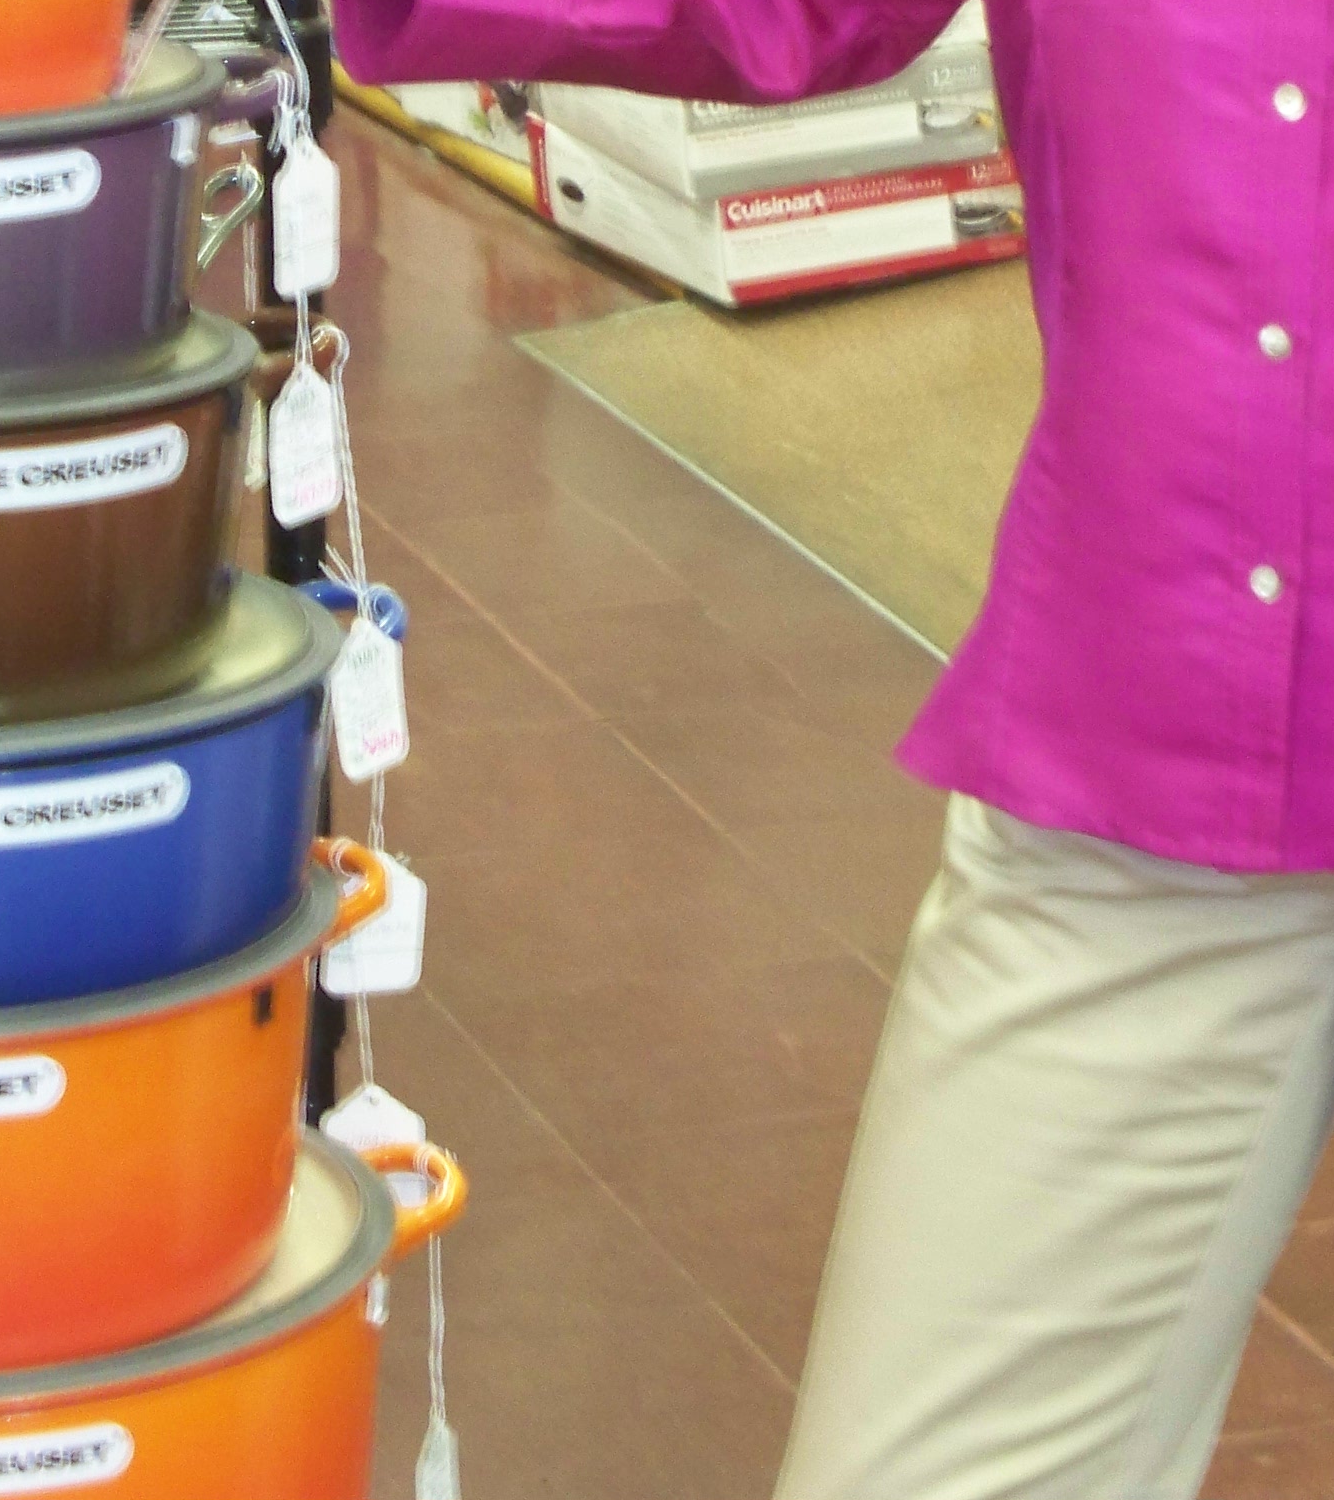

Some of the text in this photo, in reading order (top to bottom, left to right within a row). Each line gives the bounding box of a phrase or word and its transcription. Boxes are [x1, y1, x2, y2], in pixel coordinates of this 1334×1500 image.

[931, 68, 952, 87] 12
[727, 188, 826, 223] Cuisinart
[20, 441, 172, 488] CREUSET
[2, 783, 167, 827] CREUSET
